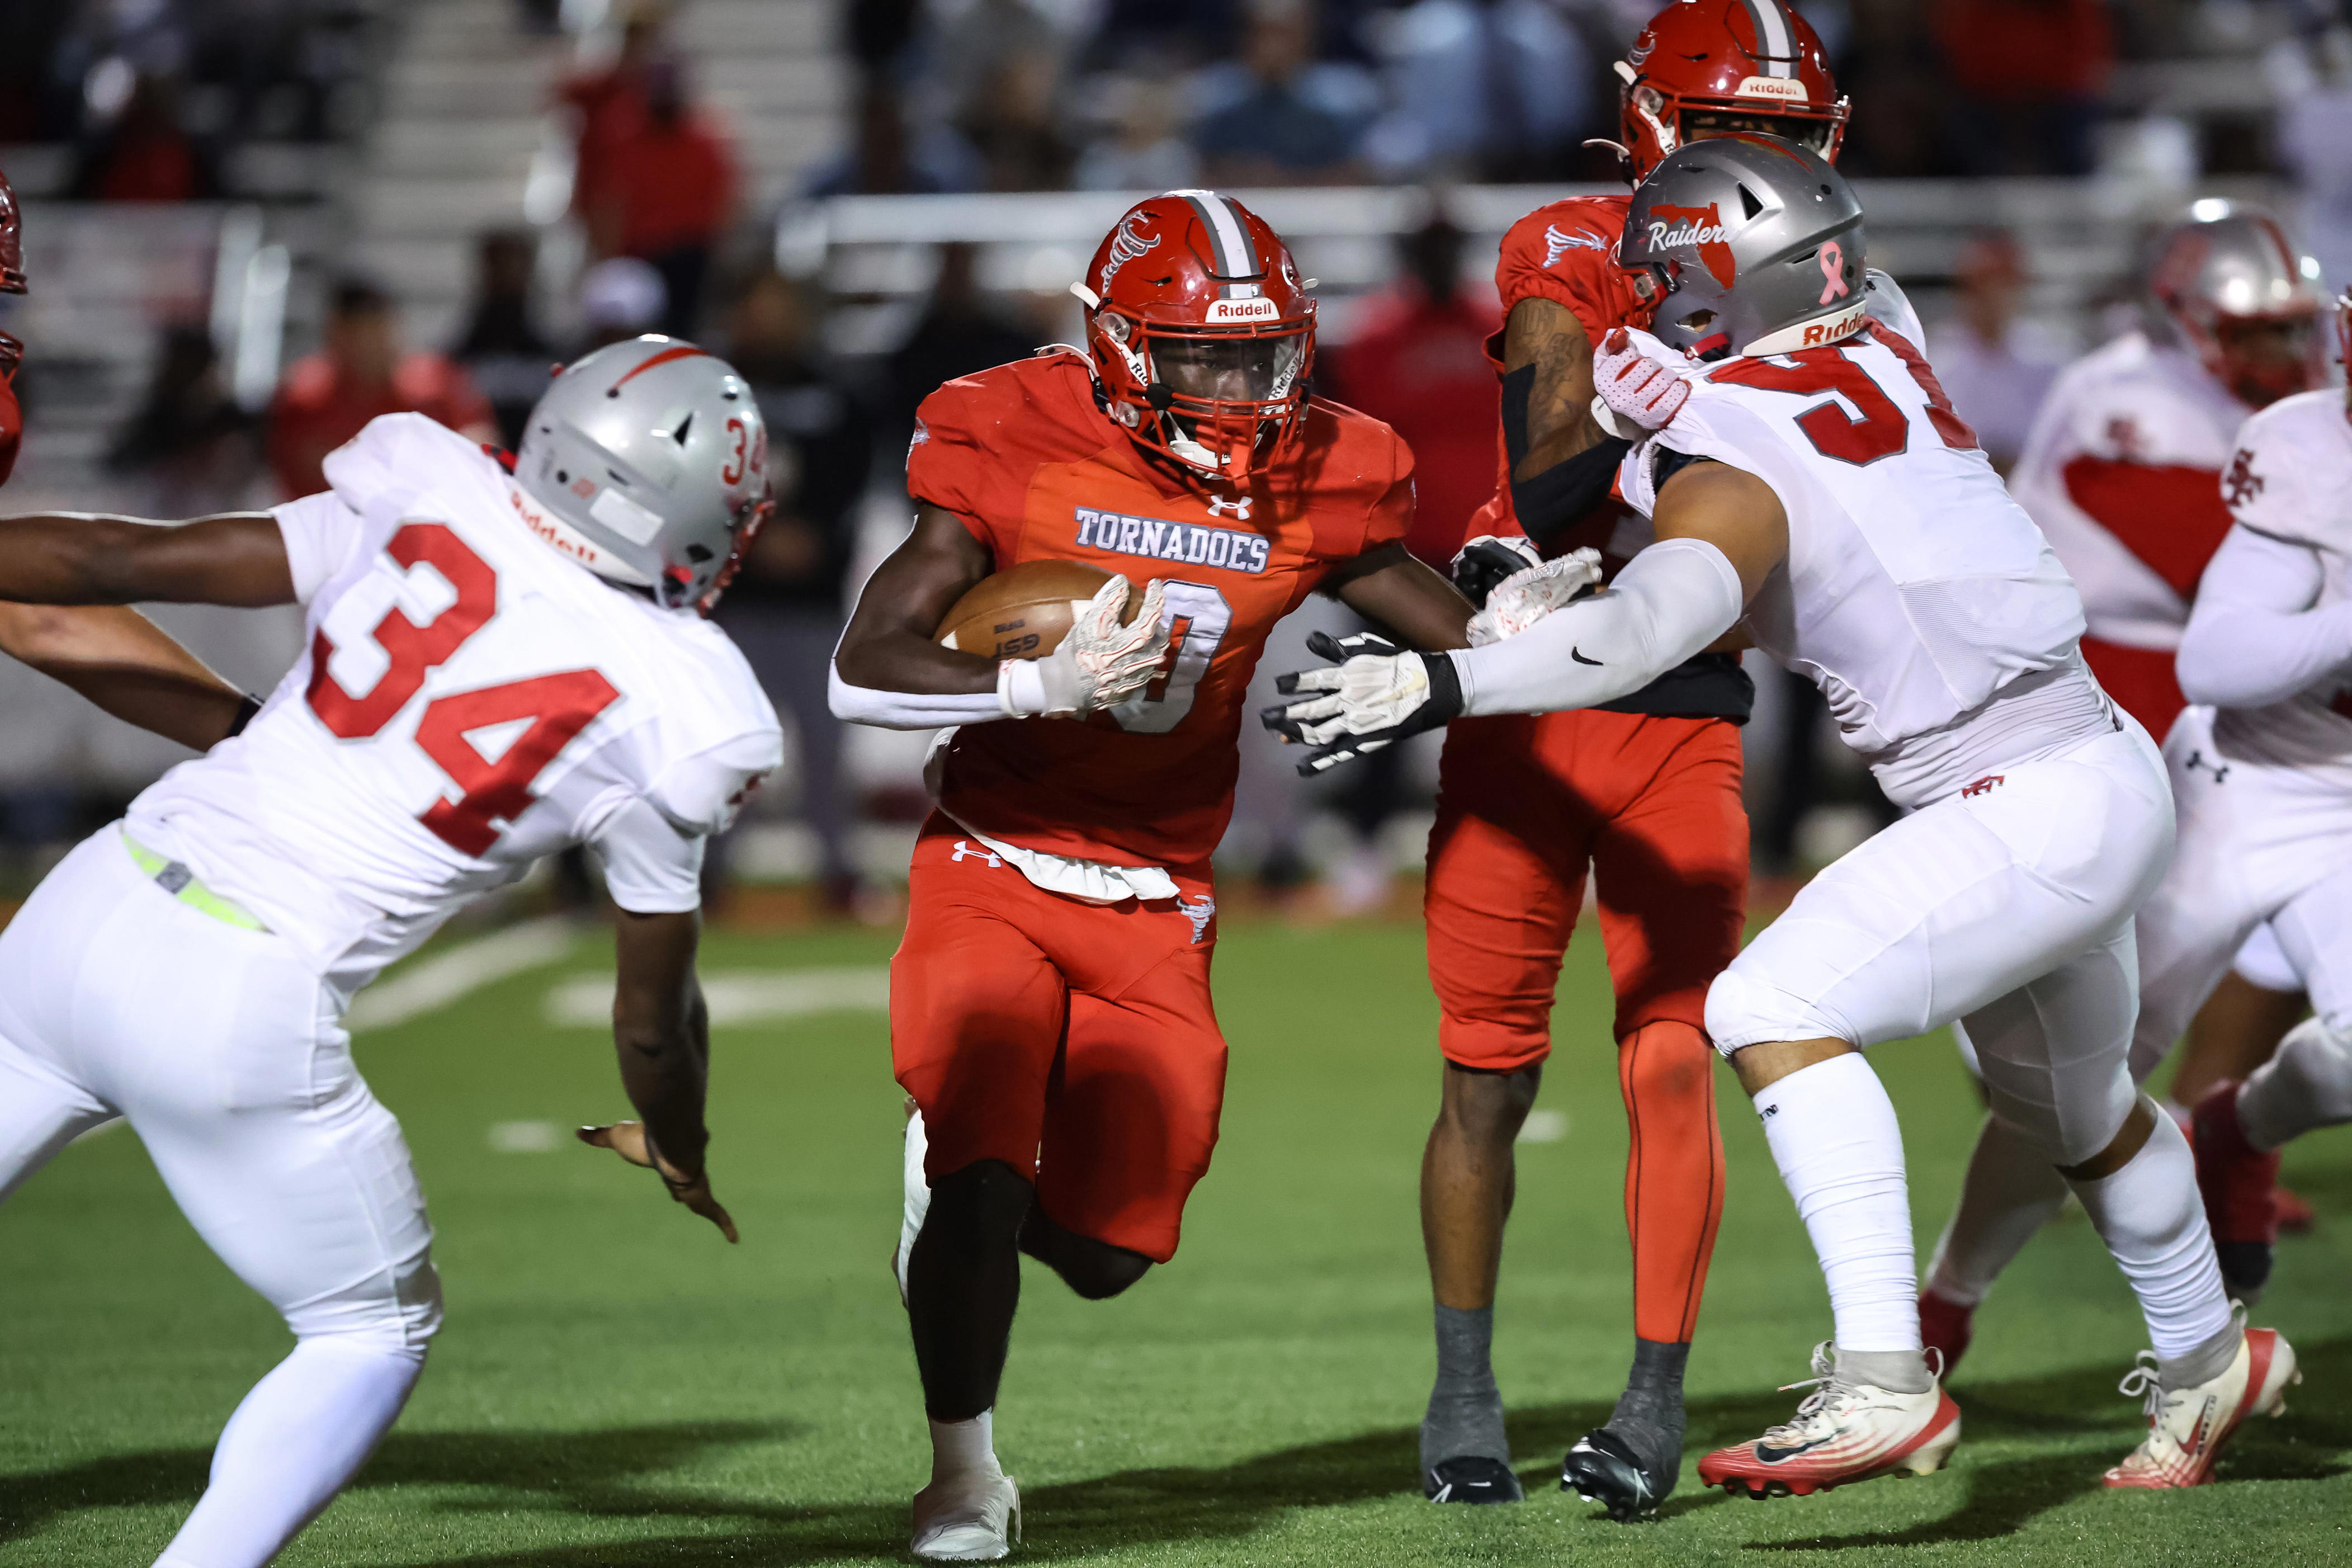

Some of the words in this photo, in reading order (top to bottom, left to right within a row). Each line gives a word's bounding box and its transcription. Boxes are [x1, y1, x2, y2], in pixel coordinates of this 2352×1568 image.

[1750, 84, 1800, 95] Riddel
[1218, 303, 1271, 317] Riddell
[1803, 312, 1864, 346] Ridde
[1075, 508, 1270, 573] TORNADOES
[304, 520, 625, 859] 34
